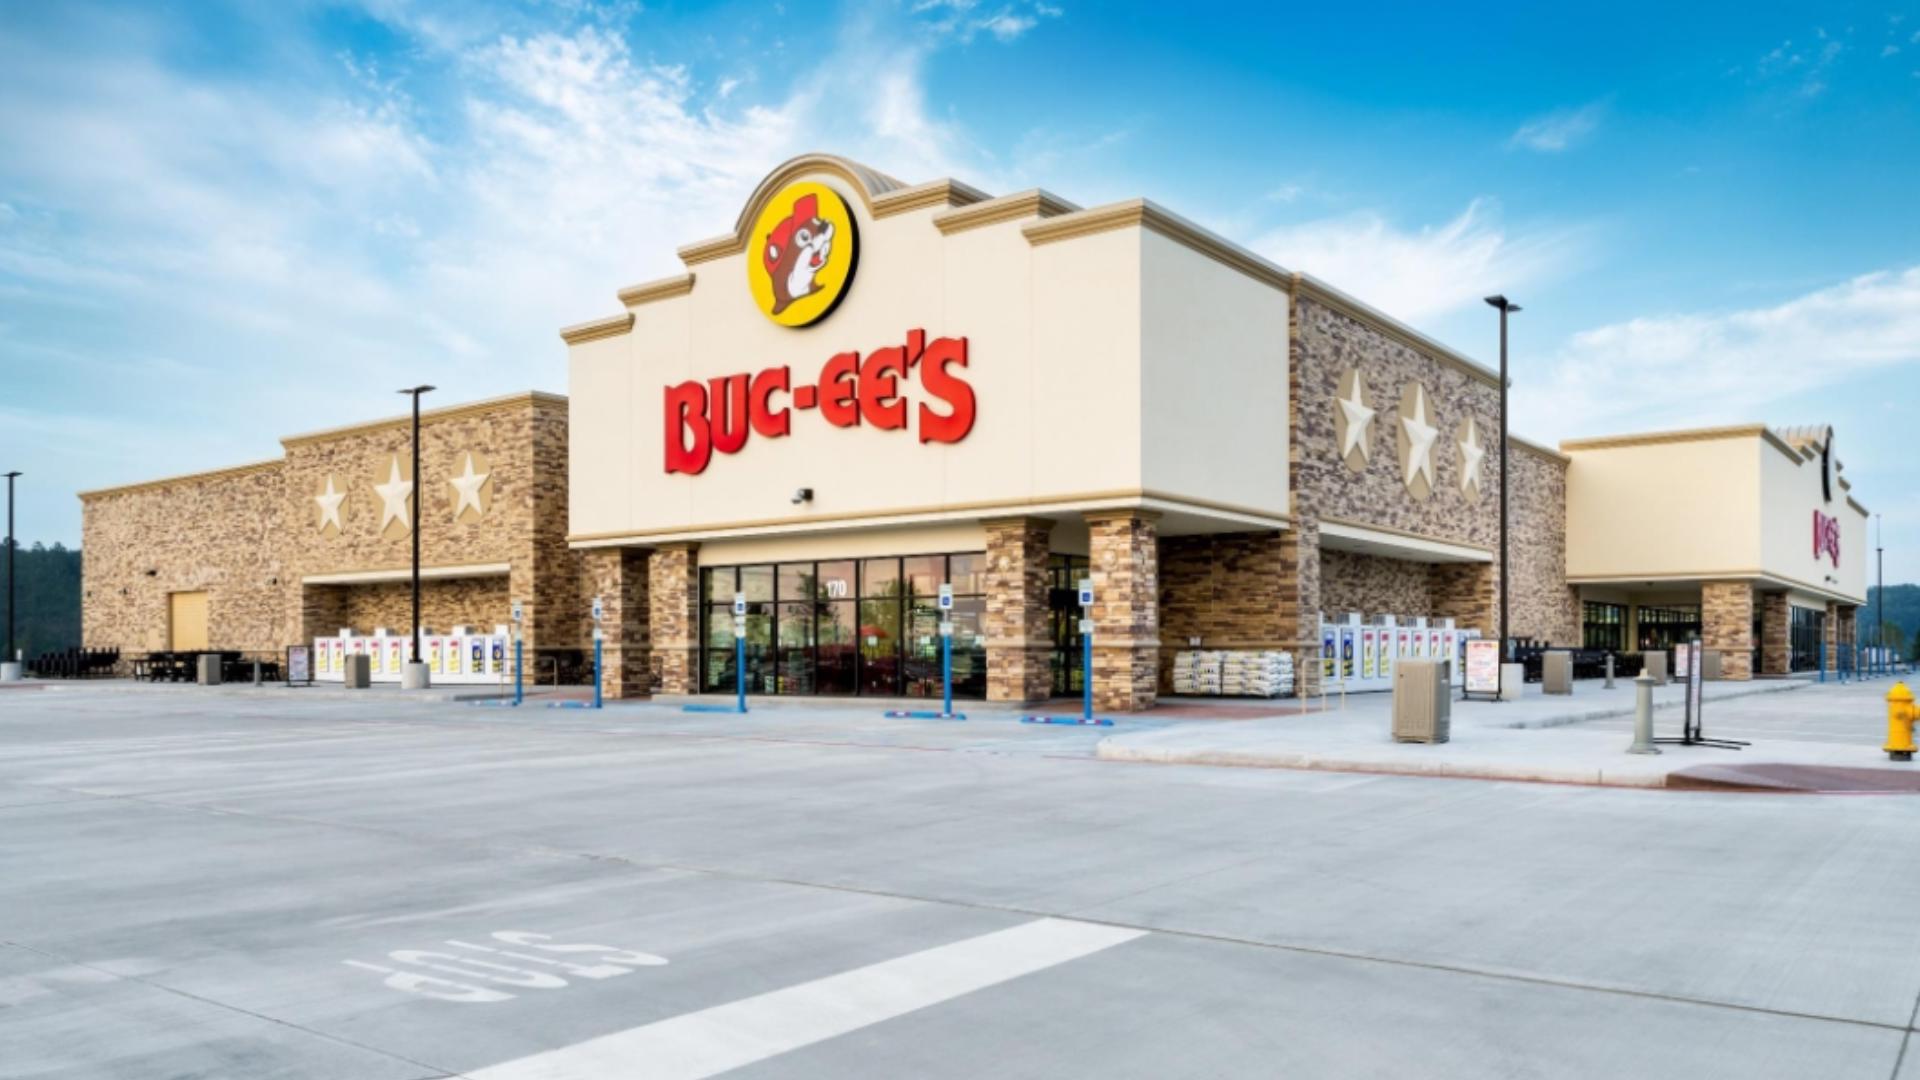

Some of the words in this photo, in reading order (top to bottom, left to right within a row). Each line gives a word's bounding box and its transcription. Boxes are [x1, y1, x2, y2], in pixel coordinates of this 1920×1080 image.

[663, 328, 977, 476] BUC-EE'S
[825, 579, 847, 598] 170
[341, 930, 669, 1003] STOP
